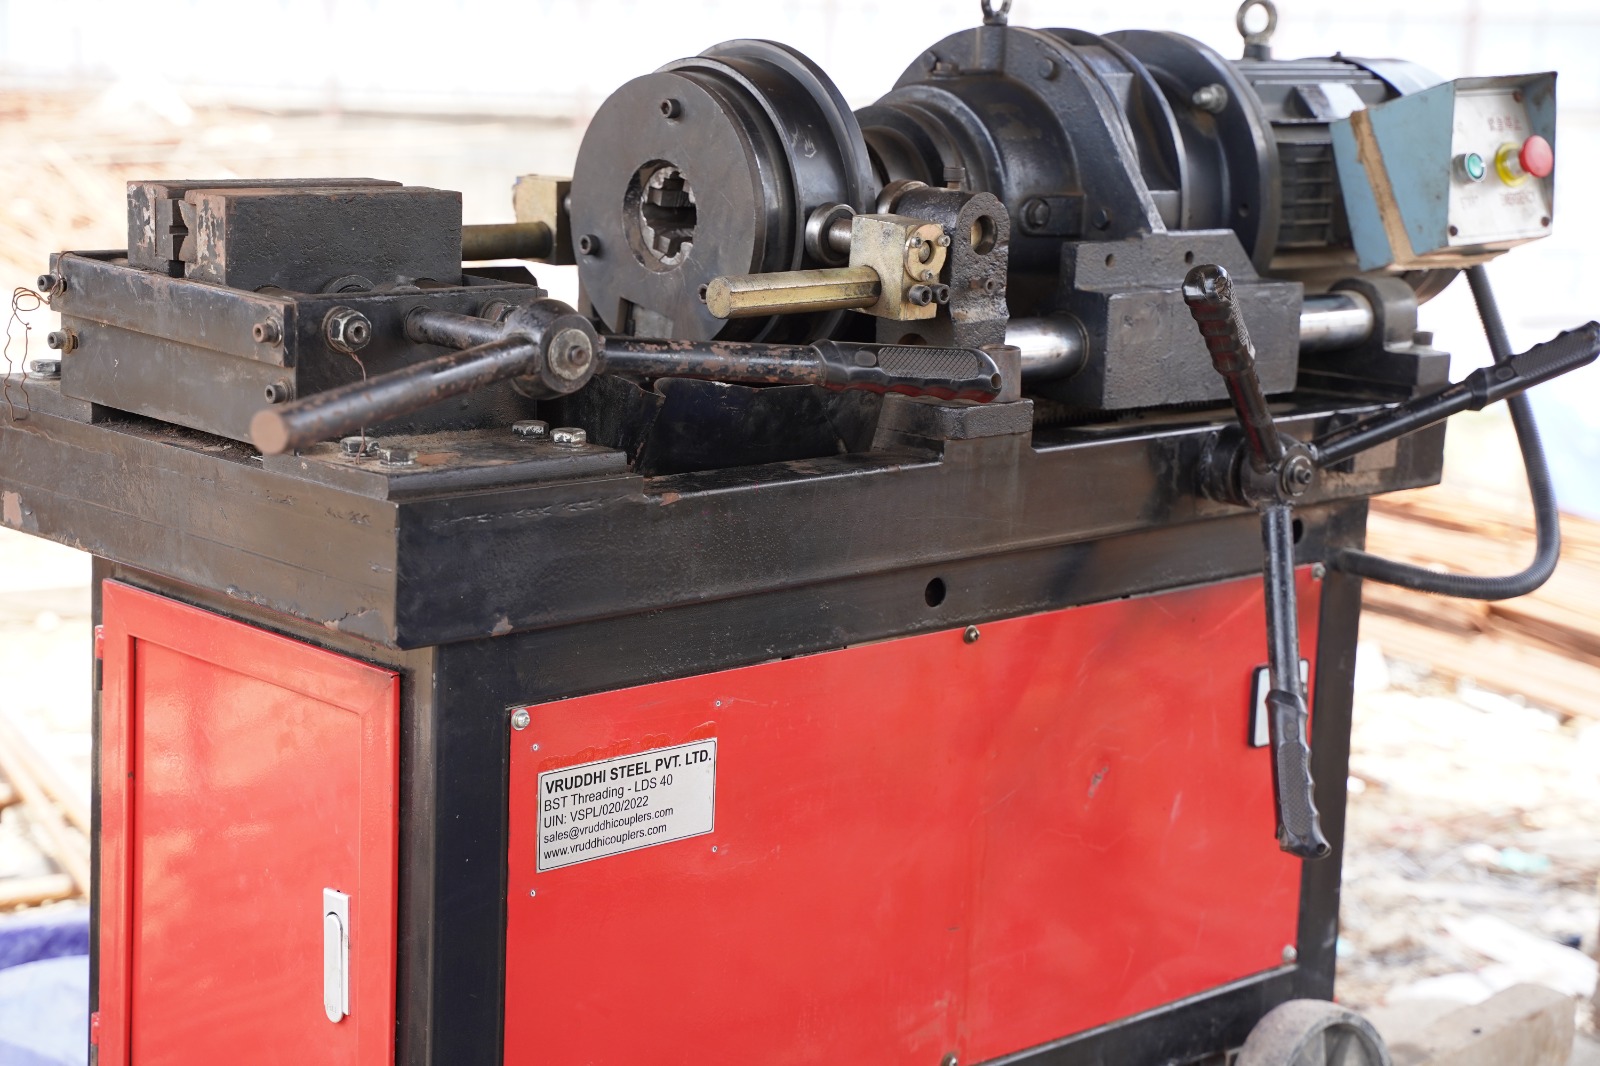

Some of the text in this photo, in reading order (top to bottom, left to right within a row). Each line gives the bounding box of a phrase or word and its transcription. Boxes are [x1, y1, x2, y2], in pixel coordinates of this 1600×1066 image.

[546, 750, 712, 794] VRUDDHI STEEL PVT. LTD.
[544, 796, 568, 811] BST
[571, 786, 624, 806] Threading
[635, 778, 657, 792] LDS
[660, 774, 673, 786] 40
[544, 796, 649, 828] UIN: VSPL/020/2022
[544, 807, 674, 844] sales@vruddhicouplers.com
[544, 824, 667, 859] www.vruddhicouplers.com
